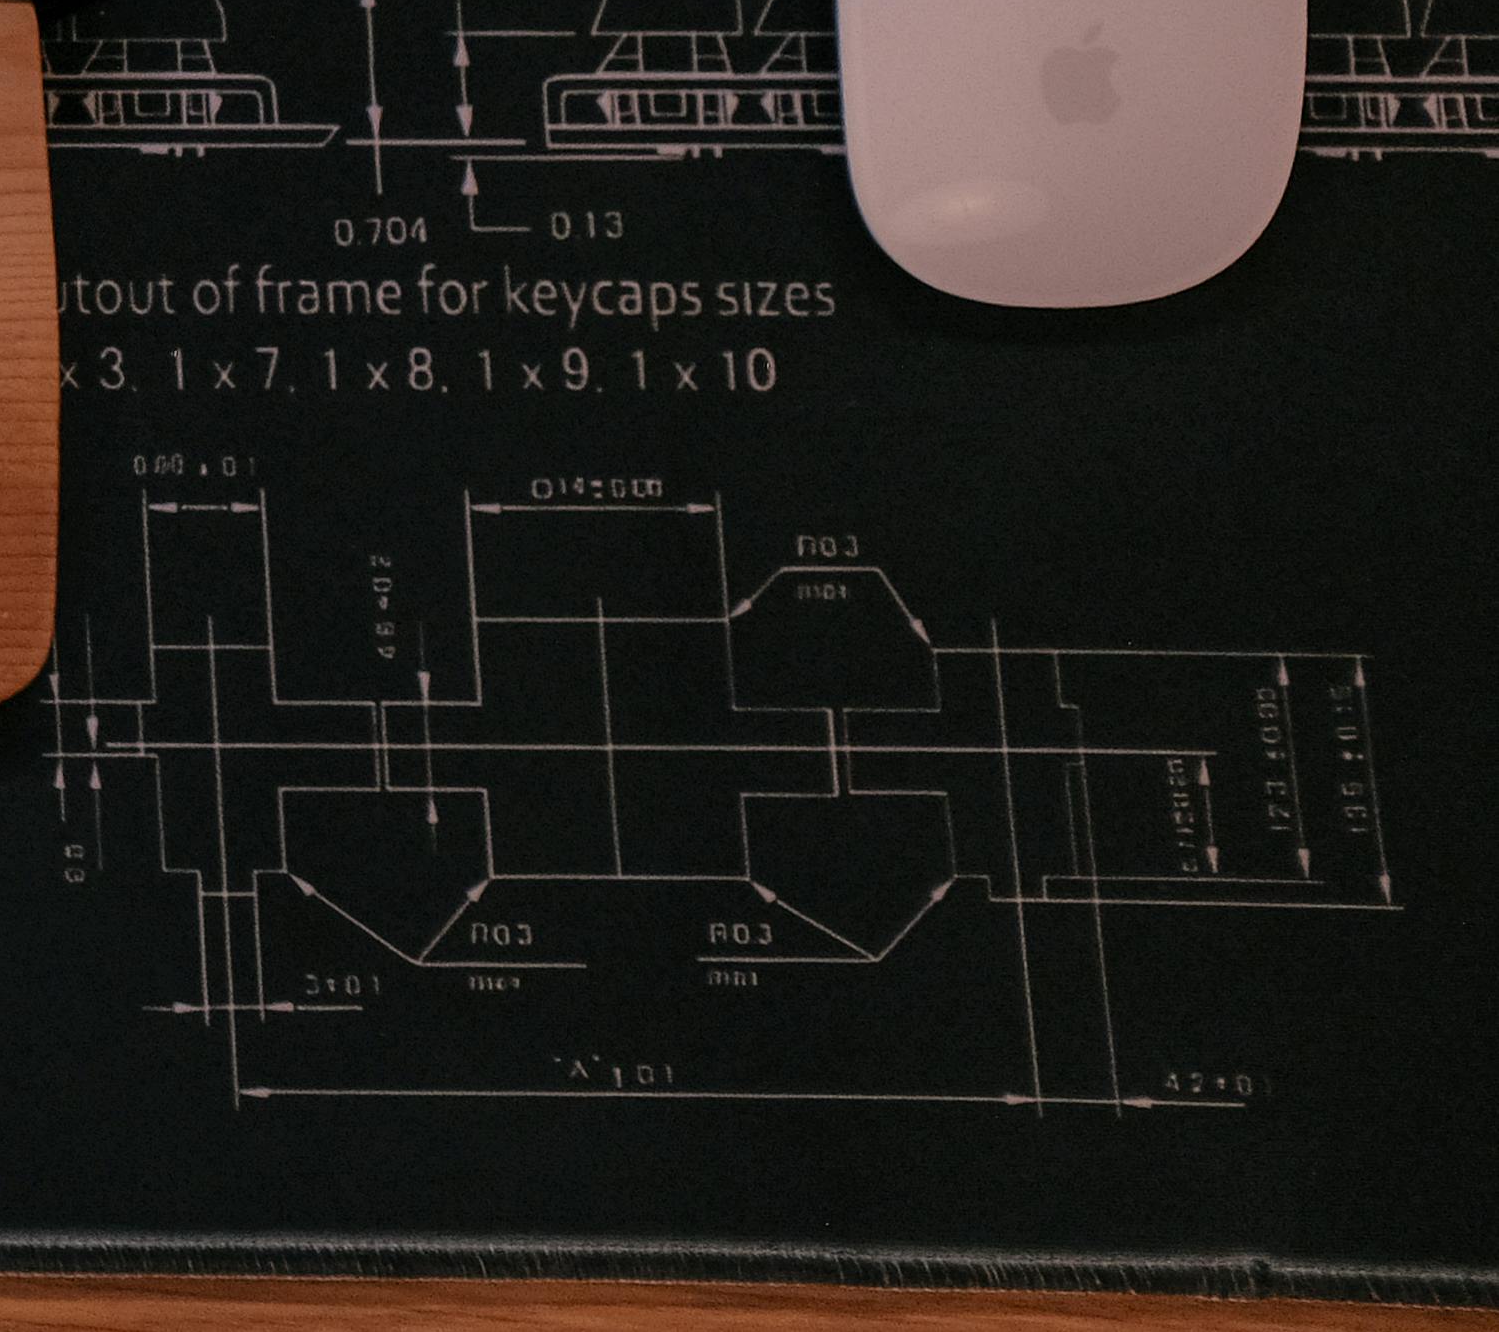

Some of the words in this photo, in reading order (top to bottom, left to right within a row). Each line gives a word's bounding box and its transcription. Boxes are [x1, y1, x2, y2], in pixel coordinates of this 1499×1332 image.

[193, 263, 240, 316] of
[255, 263, 403, 316] frame
[417, 263, 489, 316] for
[505, 263, 702, 332] keycaps
[716, 271, 837, 317] sizes
[60, 362, 80, 389] x
[173, 347, 184, 390] 1
[214, 361, 236, 389] x
[324, 347, 338, 390] 1
[367, 361, 389, 389] x
[479, 349, 493, 390] 1
[522, 362, 544, 389] x
[633, 349, 646, 390] 1
[674, 361, 698, 391] x
[722, 347, 777, 392] 10
